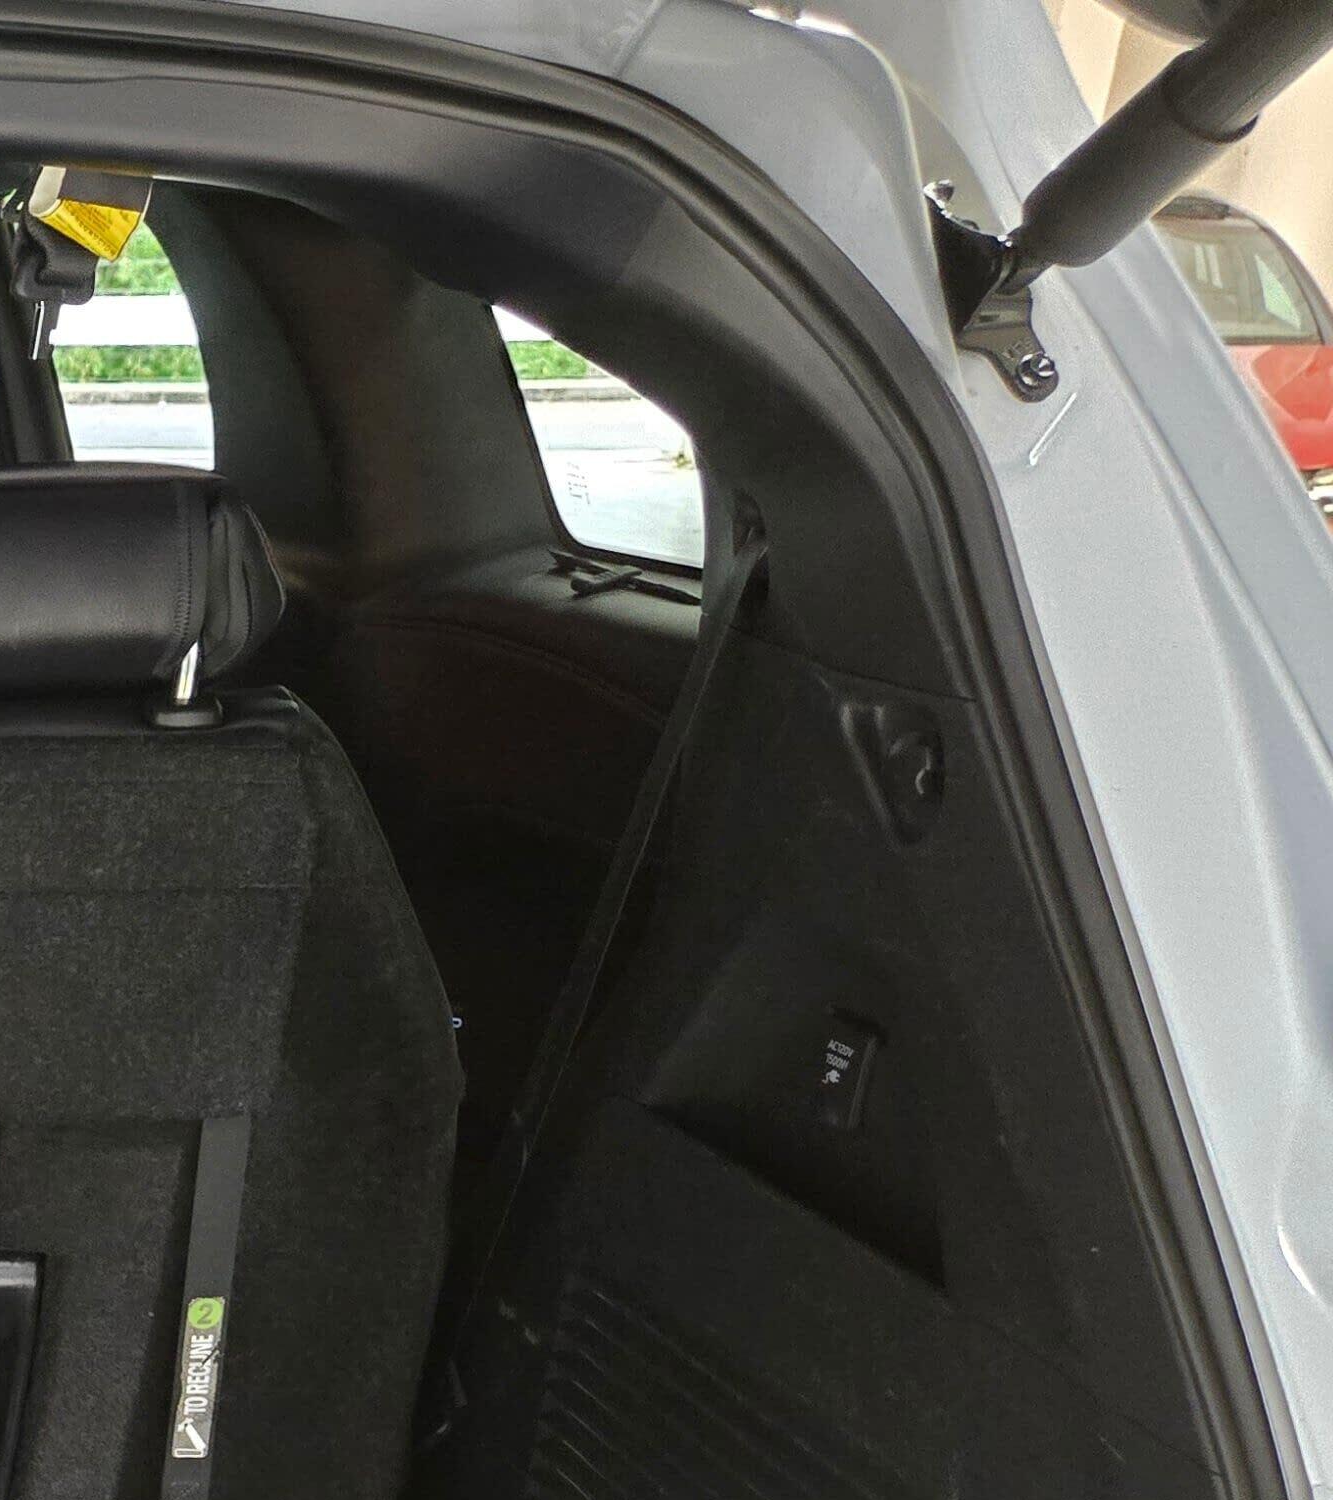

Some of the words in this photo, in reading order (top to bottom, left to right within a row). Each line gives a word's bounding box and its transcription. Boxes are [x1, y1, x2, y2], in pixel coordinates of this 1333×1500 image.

[827, 1039, 854, 1058] AC120V
[825, 1053, 850, 1069] 1500W
[196, 1303, 214, 1325] 2
[186, 1334, 214, 1394] RECLINE
[184, 1395, 210, 1415] TO
